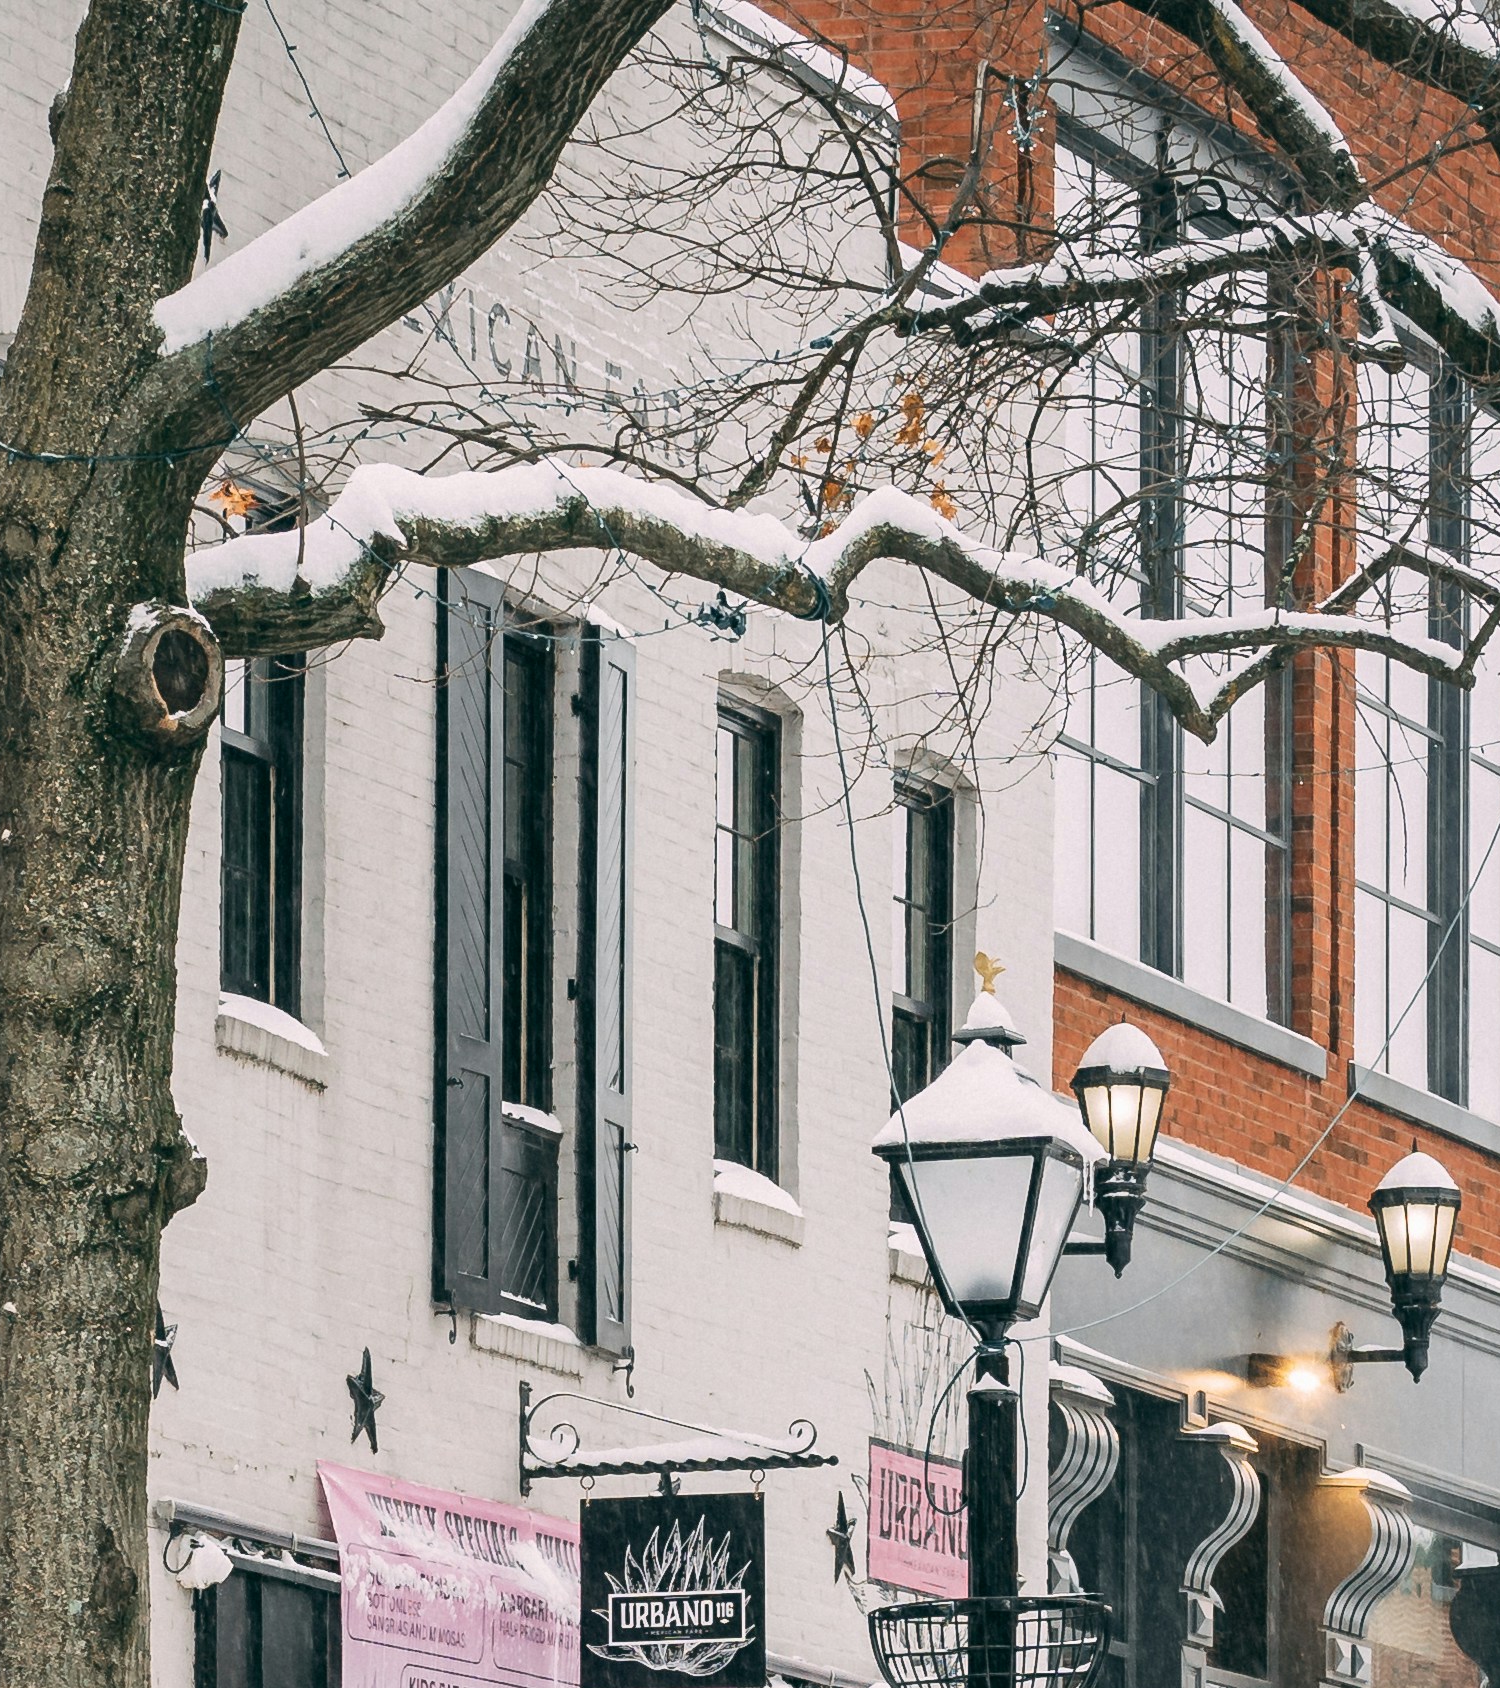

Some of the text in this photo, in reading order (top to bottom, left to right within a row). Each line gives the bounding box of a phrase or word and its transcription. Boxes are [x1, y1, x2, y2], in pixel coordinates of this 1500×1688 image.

[402, 281, 577, 399] XICAN
[620, 1599, 734, 1629] URBANO 116
